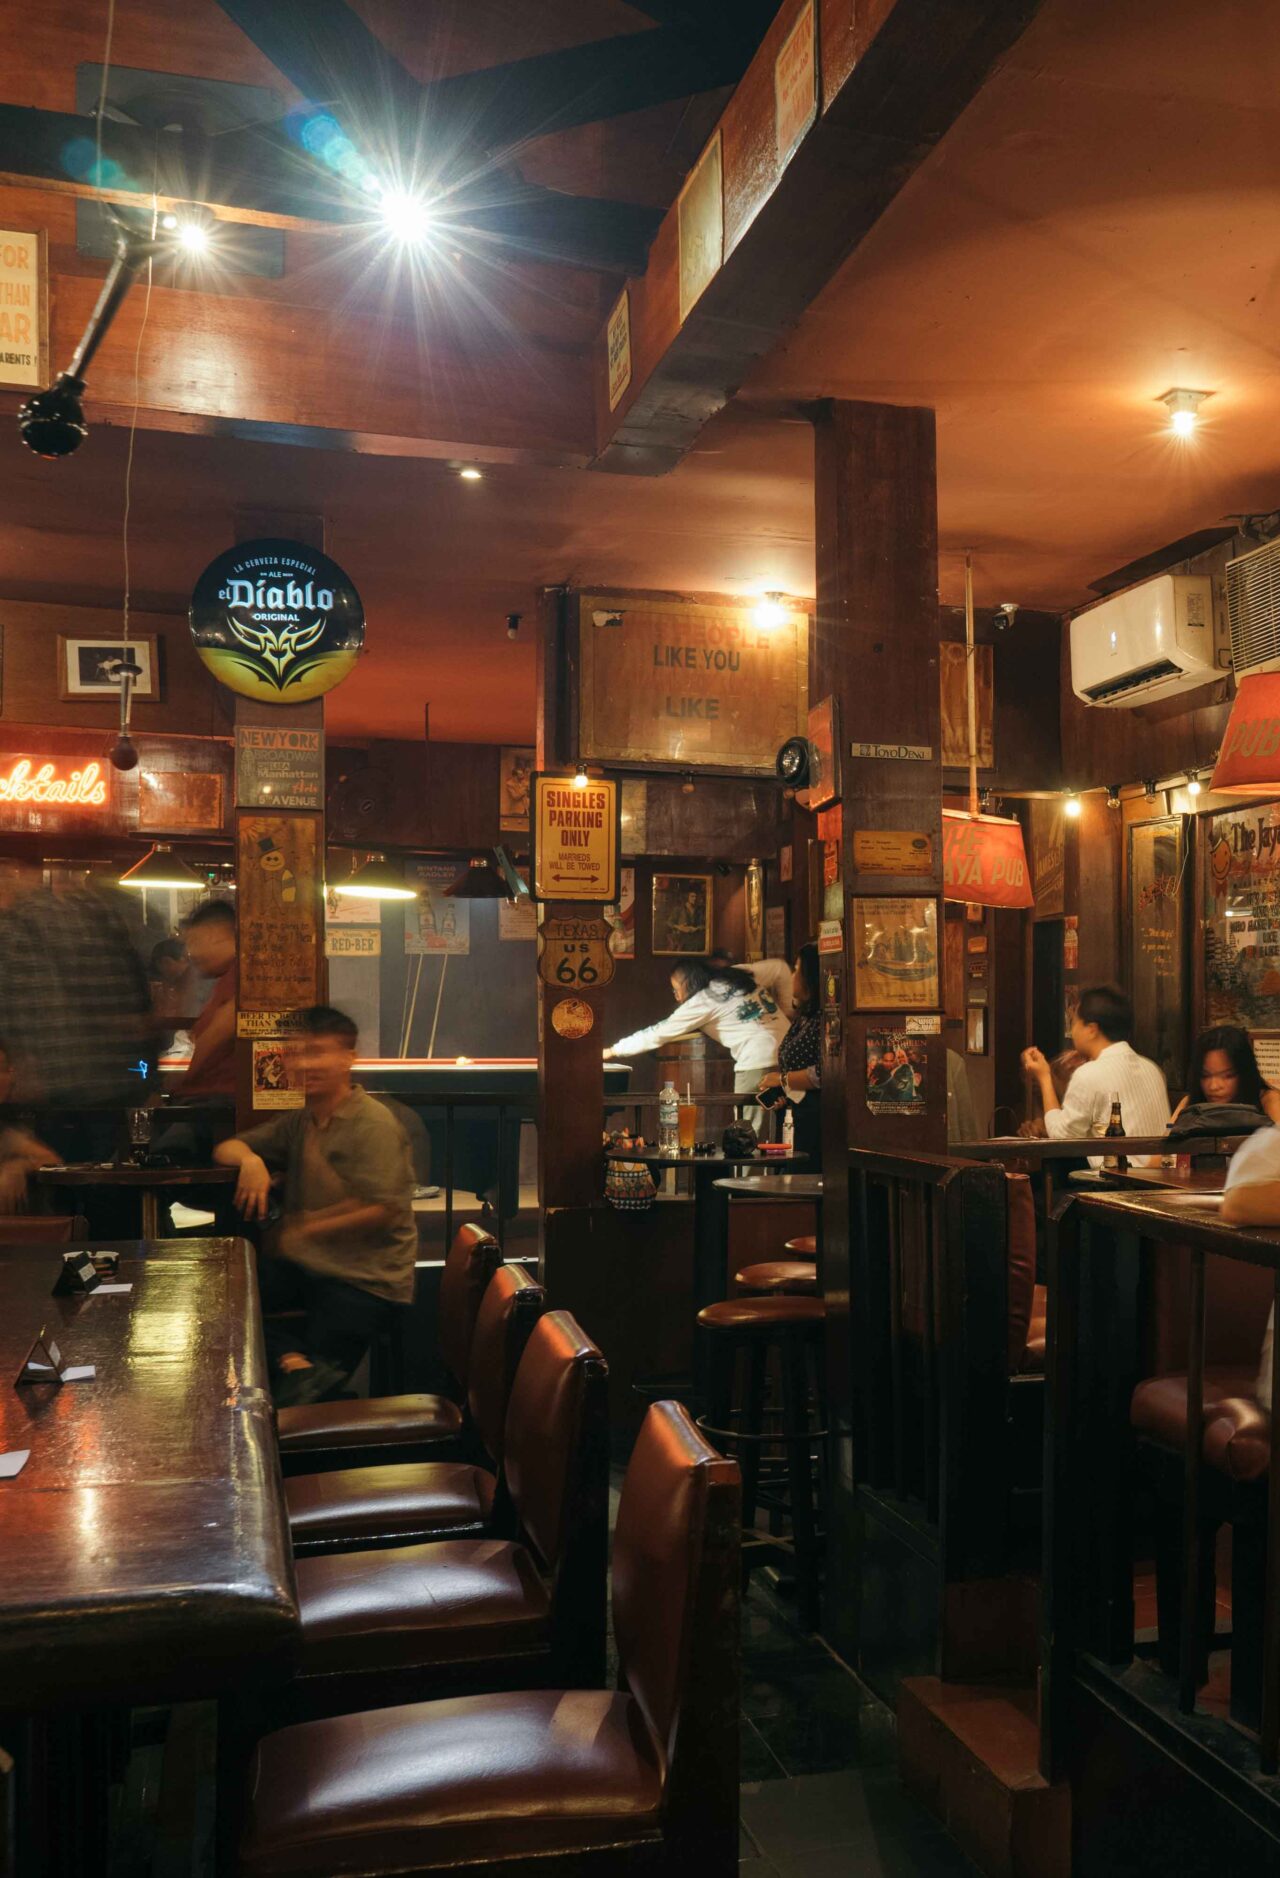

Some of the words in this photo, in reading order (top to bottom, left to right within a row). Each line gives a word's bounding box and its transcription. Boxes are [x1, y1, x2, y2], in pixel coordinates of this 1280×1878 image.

[0, 352, 31, 366] ARENTS
[233, 564, 244, 573] LA
[245, 556, 279, 569] CERVEZA
[281, 557, 317, 576] ESPECIAL
[218, 587, 231, 600] el
[253, 613, 300, 621] ORIGINAL
[653, 645, 697, 669] LIKE
[702, 649, 741, 672] YOU
[665, 695, 720, 720] LIKE
[272, 796, 317, 807] AVENUE
[546, 790, 606, 809] SINGLES
[548, 810, 603, 828] PARKING
[561, 829, 590, 847] ONLY
[1231, 821, 1255, 853] The
[548, 861, 564, 870] WILL
[566, 862, 575, 870] BE
[578, 862, 601, 871] TOWED
[990, 855, 1025, 887] PUB
[555, 924, 598, 937] TEXAS
[556, 957, 598, 984] 66
